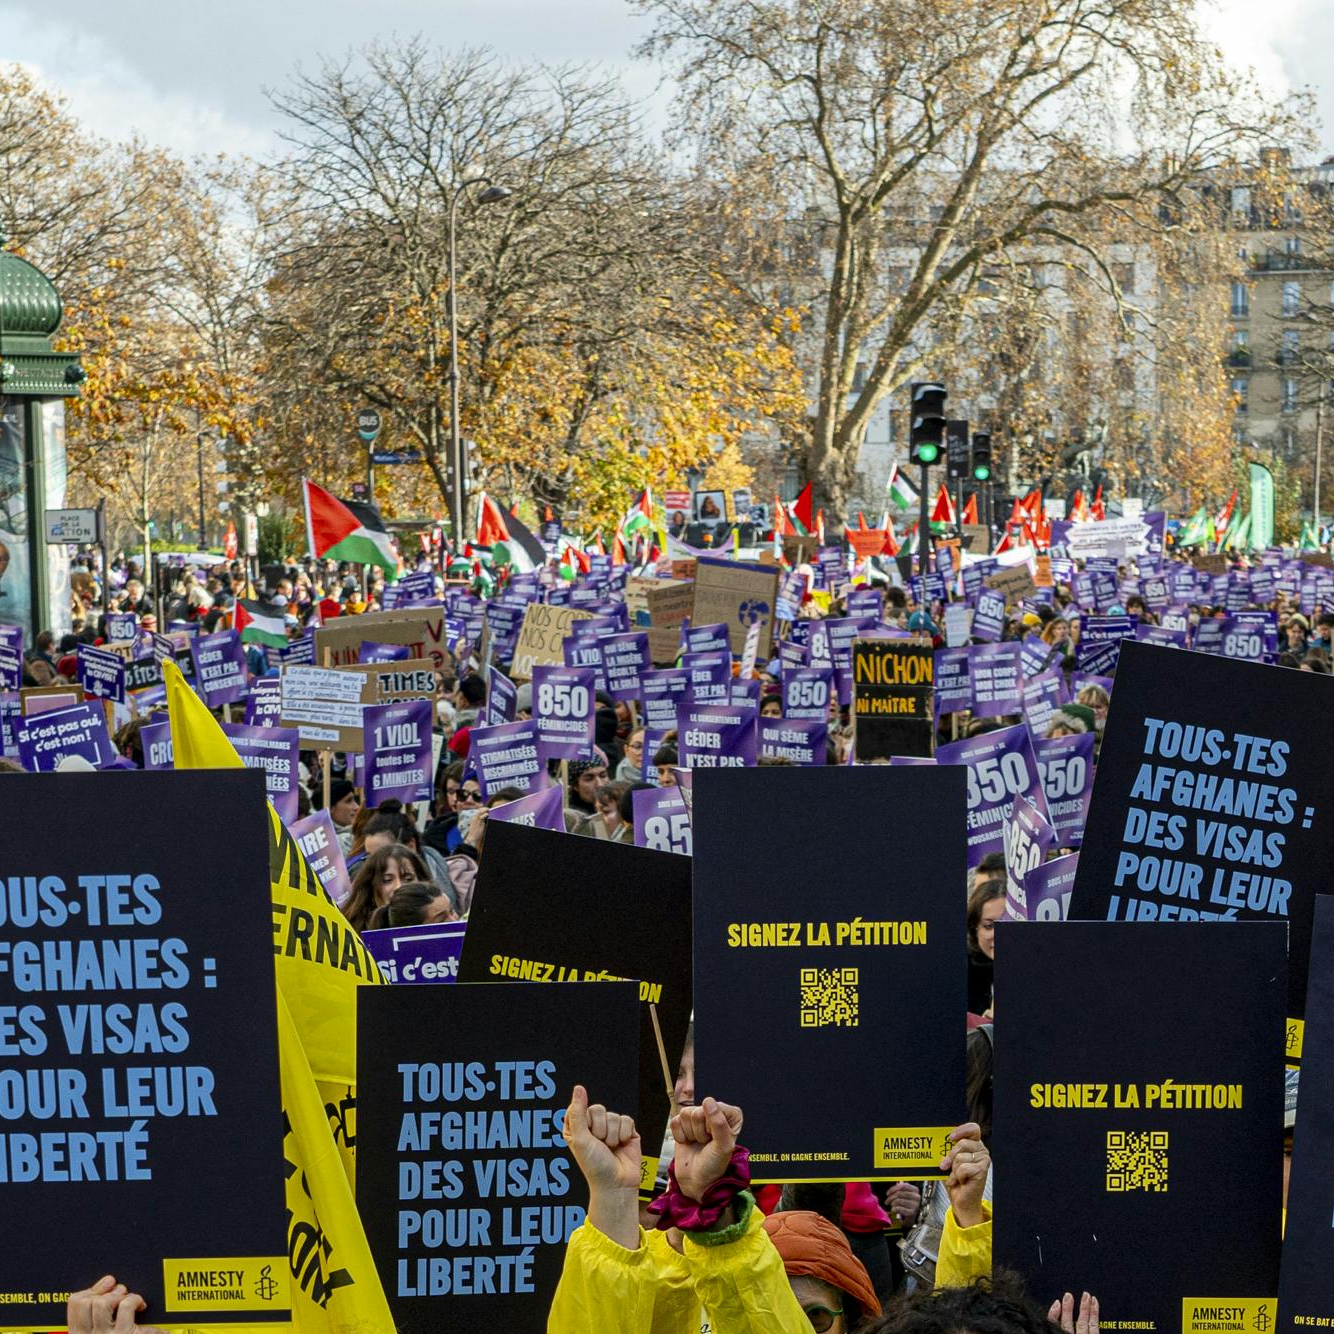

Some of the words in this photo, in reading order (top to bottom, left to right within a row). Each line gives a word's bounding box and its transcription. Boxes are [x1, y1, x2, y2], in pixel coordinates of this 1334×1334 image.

[538, 684, 589, 718] 850
[19, 729, 30, 743] Si
[58, 722, 78, 736] pas
[538, 718, 588, 732] FÉMINICIDES
[66, 732, 85, 745] non
[762, 728, 779, 742] QUI
[780, 729, 809, 744] SÈME
[376, 755, 402, 767] toutes
[403, 753, 416, 764] les
[1131, 764, 1298, 826] AFGHANES
[1123, 807, 1185, 852] DES
[1196, 819, 1286, 869] VISAS
[1115, 852, 1203, 904] POUR
[1209, 867, 1293, 918] LEUR
[727, 922, 802, 949] SIGNEZ
[807, 922, 831, 947] LA
[836, 916, 927, 947] PÉTITION
[58, 1002, 190, 1055] VISAS
[102, 1067, 217, 1118] LEUR
[1030, 1083, 1108, 1109] SIGNEZ
[1114, 1084, 1140, 1109] LA
[1146, 1079, 1243, 1109] PÉTITION
[883, 1137, 933, 1150] AMNESTY
[791, 1152, 813, 1161] GAGNE
[814, 1152, 850, 1161] ENSEMBLE.
[883, 1151, 933, 1160] INTERNATIONAL
[398, 1160, 463, 1200] DES
[473, 1158, 570, 1199] VISAS
[398, 1209, 490, 1249] POUR
[178, 1271, 244, 1287] AMNESTY
[398, 1247, 535, 1298] LIBERTÉ
[177, 1288, 245, 1301] INTERNATIONAL
[1192, 1308, 1246, 1321] AMNESTY
[1316, 1317, 1331, 1327] BAT
